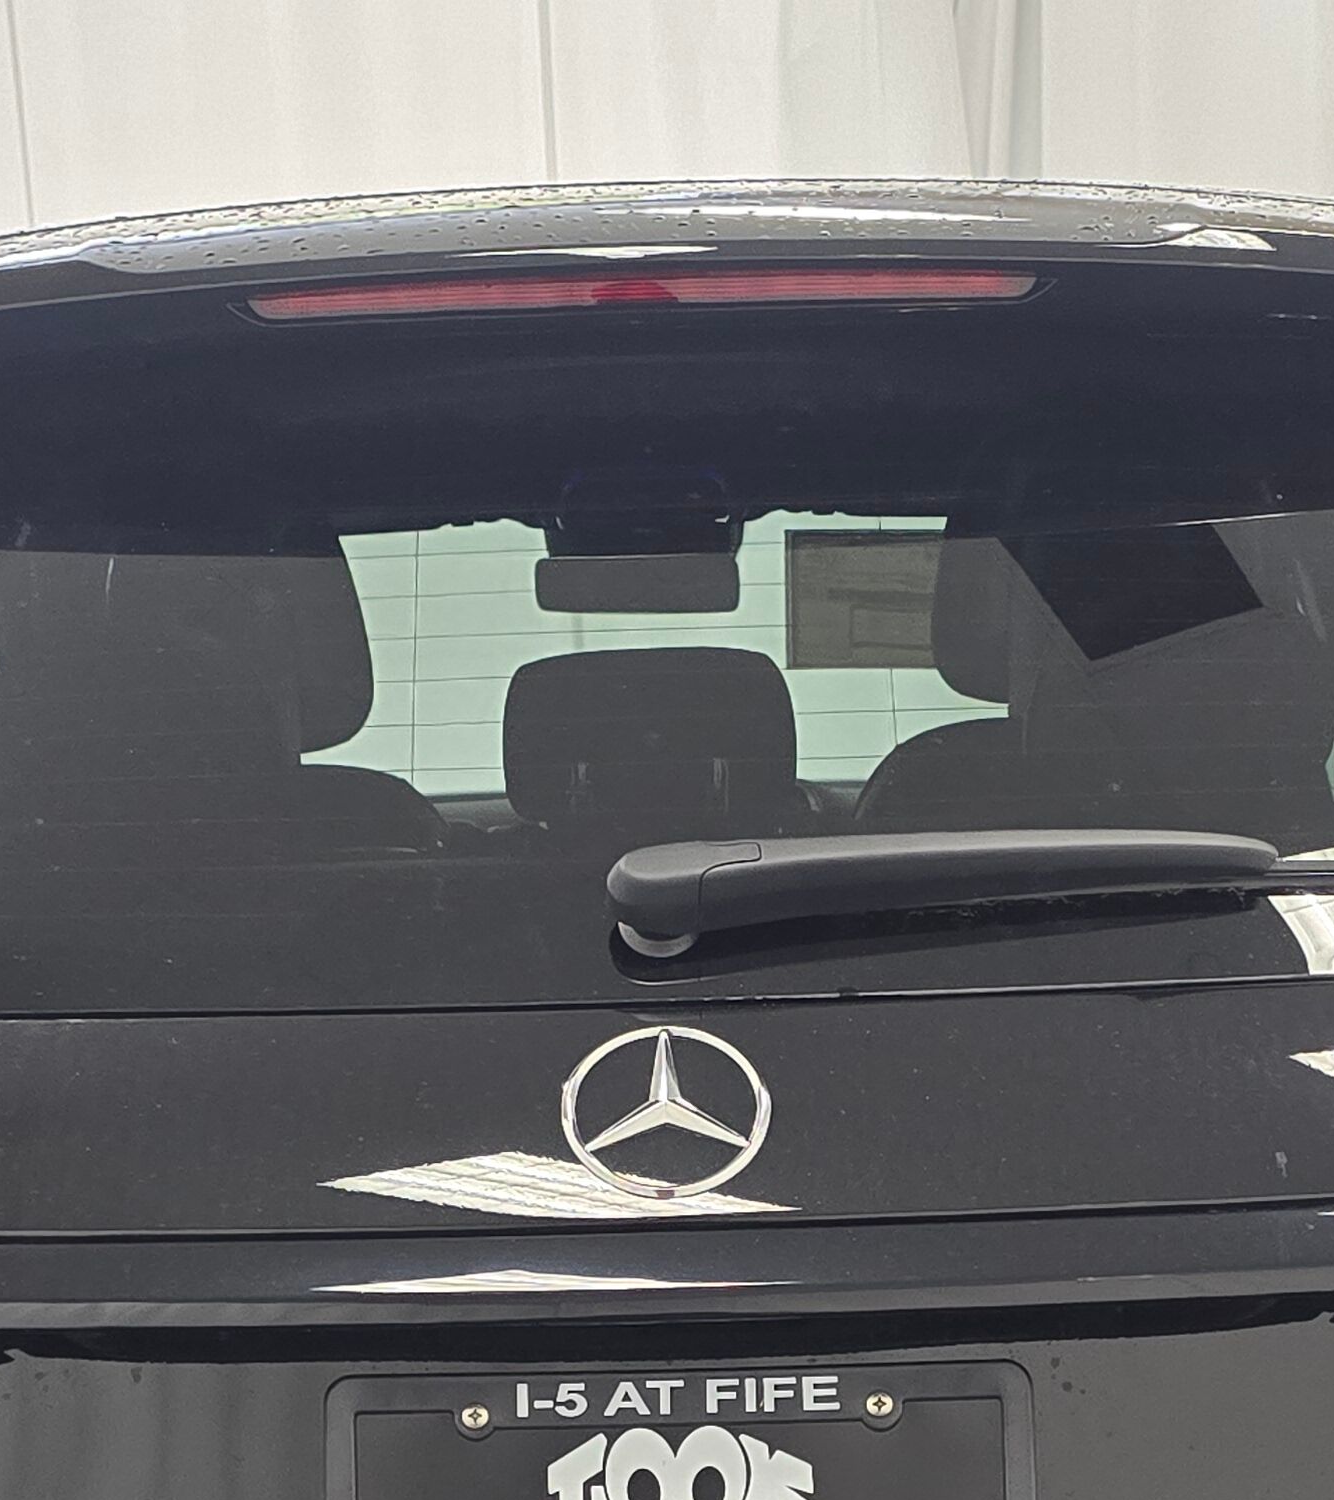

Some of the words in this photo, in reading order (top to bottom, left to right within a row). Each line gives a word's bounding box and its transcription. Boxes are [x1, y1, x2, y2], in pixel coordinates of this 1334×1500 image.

[516, 1382, 588, 1418] I-5
[603, 1380, 684, 1416] AT
[705, 1376, 841, 1413] FIFE
